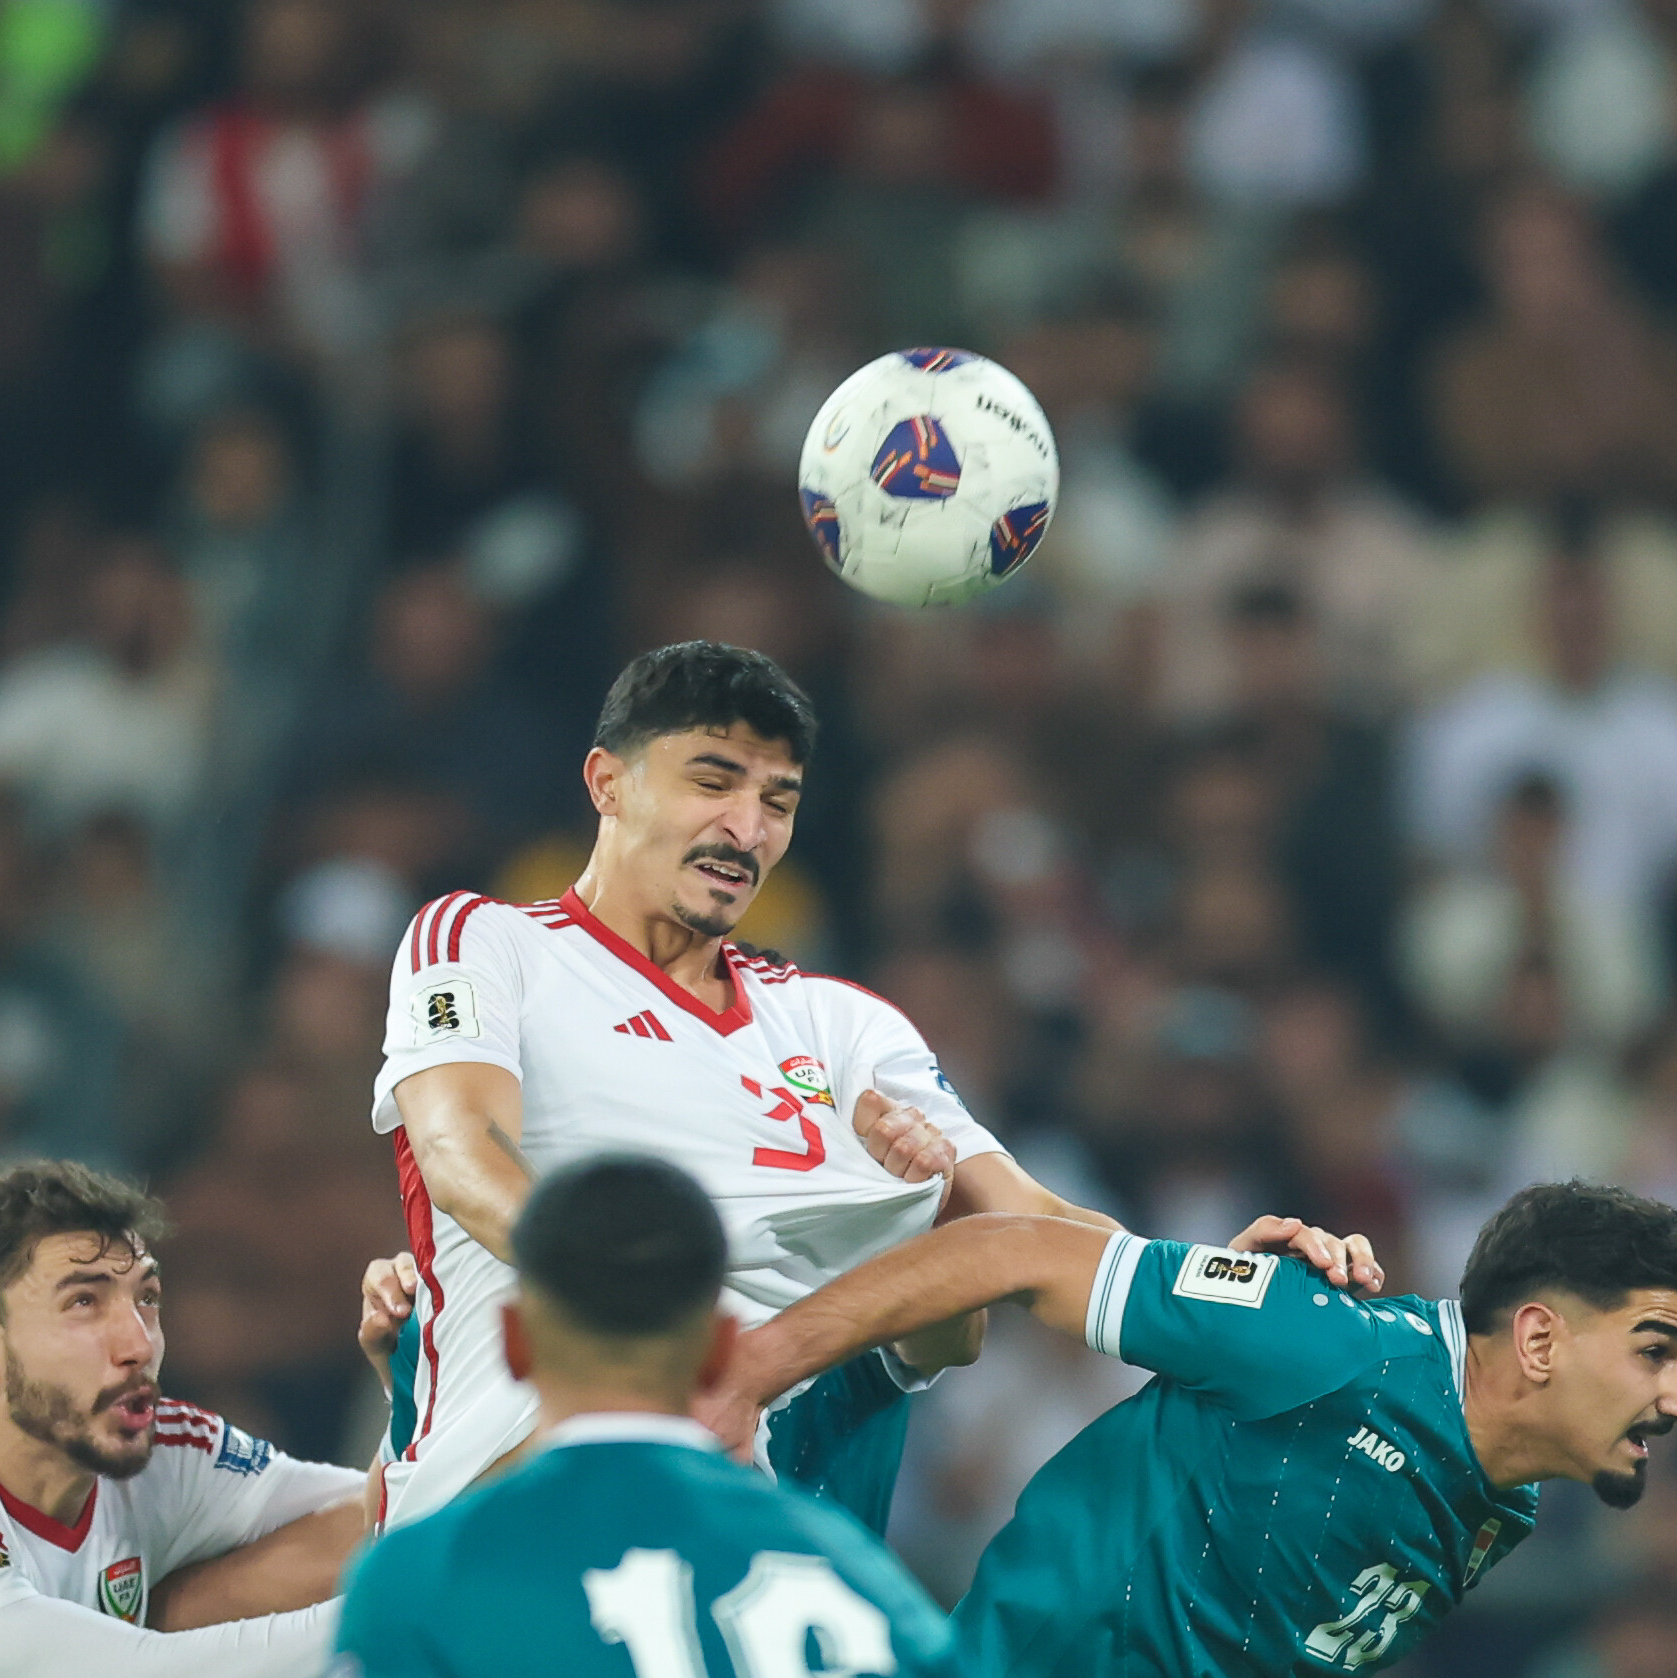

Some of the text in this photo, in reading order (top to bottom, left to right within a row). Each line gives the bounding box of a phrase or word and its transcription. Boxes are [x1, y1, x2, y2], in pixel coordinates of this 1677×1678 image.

[740, 1074, 826, 1172] 3
[1347, 1426, 1406, 1473] JAKO
[1304, 1562, 1432, 1672] 23
